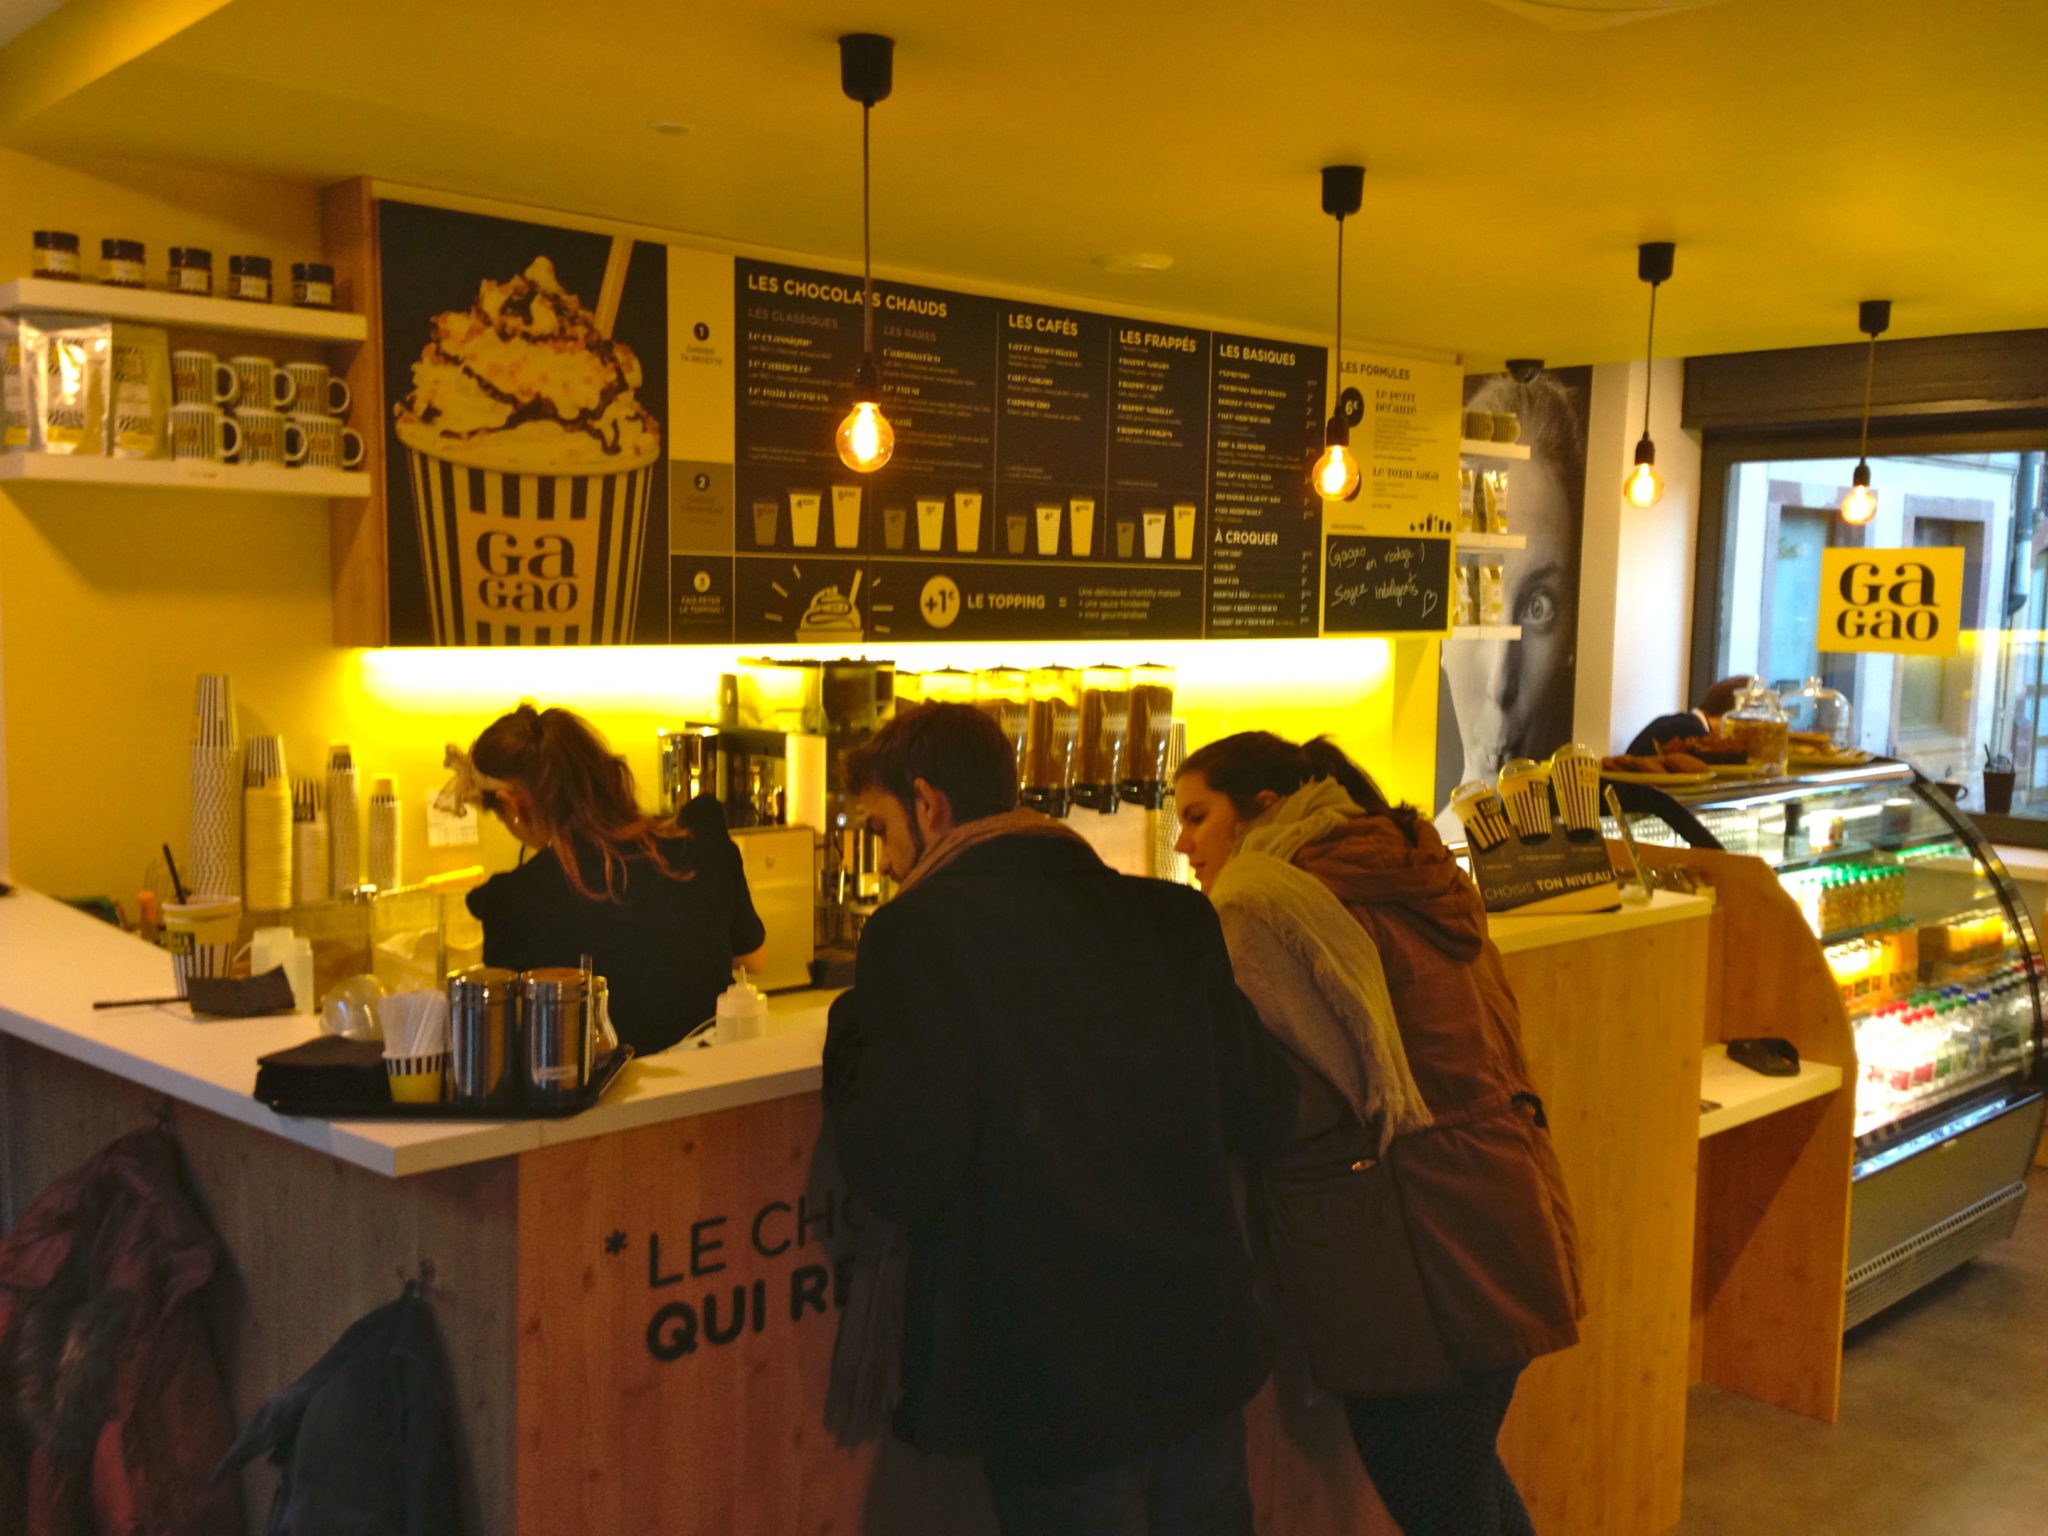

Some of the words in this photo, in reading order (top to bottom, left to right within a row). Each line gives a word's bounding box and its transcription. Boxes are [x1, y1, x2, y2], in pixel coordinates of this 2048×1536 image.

[748, 273, 778, 293] LES
[784, 279, 881, 308] CHOCOLAS
[885, 294, 948, 318] CHAUDS
[748, 307, 768, 320] LES
[771, 310, 839, 330] CLASSIQUES
[883, 325, 902, 338] LES
[1008, 313, 1033, 330] LES
[1035, 317, 1078, 337] CAFÉS
[1120, 328, 1142, 346] LES
[1144, 332, 1198, 354] FRAPPÉS
[1219, 344, 1240, 358] LES
[1242, 347, 1297, 367] BASIQUES
[1340, 361, 1358, 373] LES
[1360, 363, 1411, 381] FORMULES
[698, 476, 707, 488] 2
[1214, 526, 1223, 544] À
[1225, 530, 1279, 546] CROQUER
[476, 529, 580, 580] Ga
[478, 578, 579, 614] Gao
[1839, 561, 1940, 608] Ga
[967, 592, 984, 610] LE
[988, 594, 1046, 612] TOPPING
[1836, 608, 1940, 642] Gao
[1484, 880, 1535, 900] CHOISIS
[1536, 876, 1564, 892] TON
[1565, 870, 1612, 886] NIVEAU
[650, 1214, 729, 1291] LE
[646, 1277, 767, 1361] QUI
